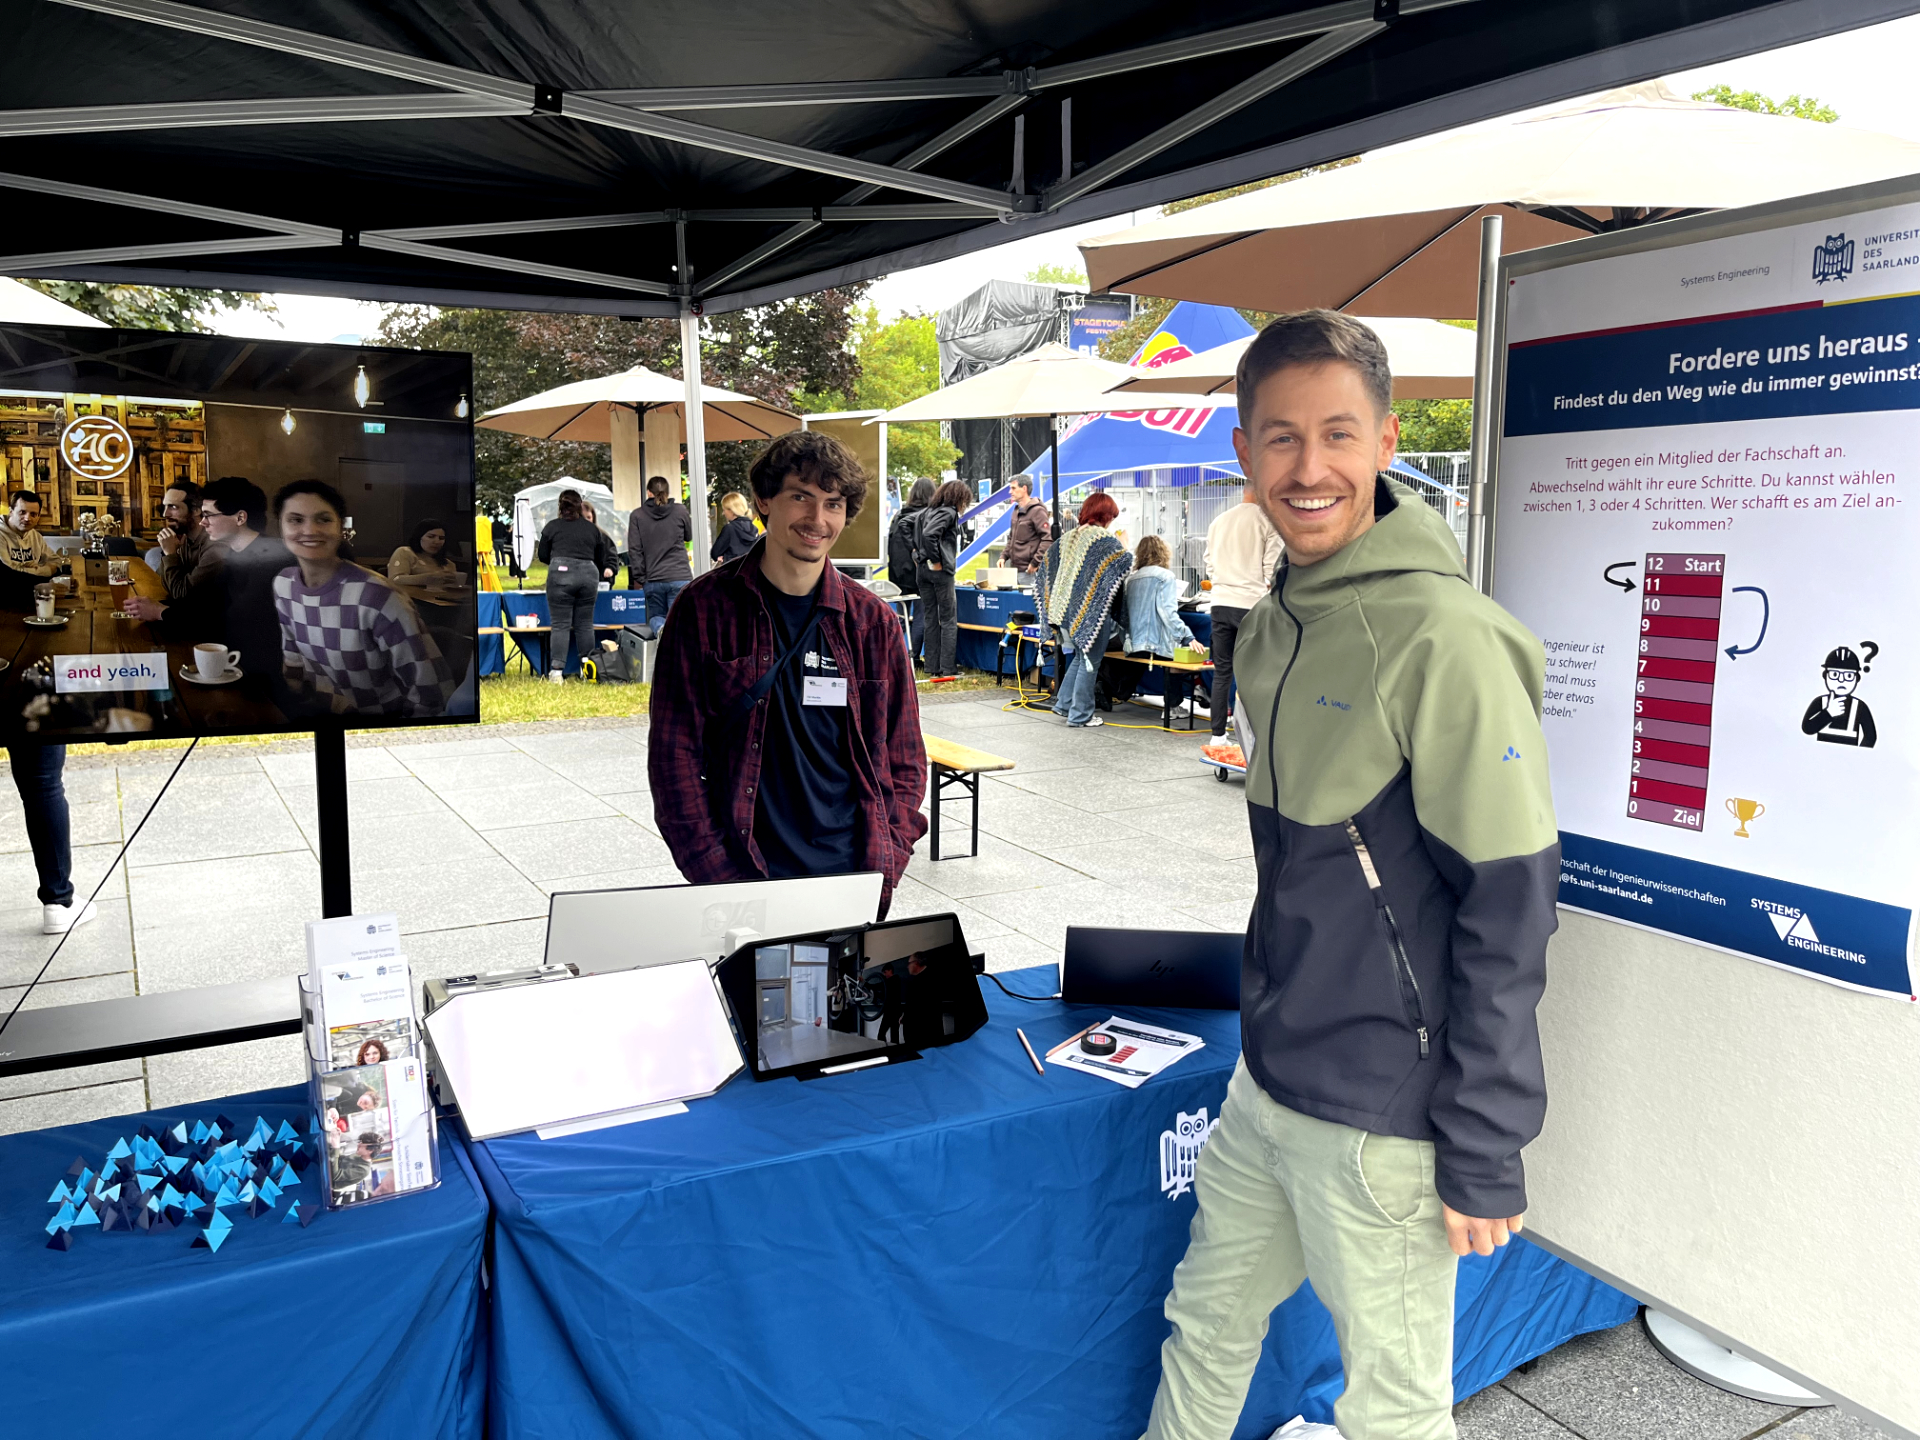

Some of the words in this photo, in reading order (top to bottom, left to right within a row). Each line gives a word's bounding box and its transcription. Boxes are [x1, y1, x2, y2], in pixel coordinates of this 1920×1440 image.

[1864, 228, 1920, 246] UNIVERSIT
[1863, 248, 1882, 259] DES
[1862, 255, 1920, 272] SAARLAND
[1681, 275, 1715, 288] Systems
[1717, 265, 1770, 281] Engineering
[1073, 318, 1127, 328] STAGETOPIA
[1668, 347, 1760, 374] Fordere
[1767, 342, 1811, 365] uns
[1818, 333, 1908, 359] heraus
[1553, 393, 1605, 411] Findest
[1607, 390, 1628, 406] du
[1632, 387, 1662, 404] den
[1666, 384, 1703, 403] Weg
[1708, 380, 1737, 397] wie
[1741, 377, 1763, 394] du
[1768, 375, 1826, 392] immer
[70, 432, 126, 464] AC
[1565, 457, 1588, 470] Tritt
[1591, 456, 1631, 472] gegen
[1634, 453, 1654, 467] ein
[1658, 450, 1714, 468] Mitglied
[1717, 449, 1741, 463] der
[1744, 444, 1820, 462] Fachschaft
[1824, 446, 1847, 459] an.
[1529, 479, 1605, 494] Abwechselnd
[1608, 477, 1643, 492] wählt
[1646, 477, 1664, 491] ihr
[1667, 477, 1697, 490] eure
[1701, 474, 1756, 489] Schritte.
[1761, 473, 1781, 487] Du
[1786, 472, 1835, 487] kannst
[1839, 469, 1896, 485] wählen
[1523, 500, 1572, 513] zwischen
[1576, 499, 1586, 513] 1,
[1589, 498, 1596, 512] 3
[1600, 498, 1629, 511] oder
[1632, 498, 1641, 511] 4
[1644, 497, 1706, 511] Schritten.
[1711, 496, 1738, 510] Wer
[1741, 494, 1790, 509] schafft
[1793, 496, 1809, 509] es
[1813, 496, 1837, 508] am
[1842, 493, 1871, 508] Ziel
[1875, 495, 1902, 508] an-
[1652, 517, 1733, 531] zukommen?
[1647, 557, 1664, 571] 12
[1684, 558, 1722, 572] Start
[1645, 578, 1661, 591] 11
[1644, 598, 1661, 612] 10
[1641, 618, 1650, 632] 9
[1543, 639, 1590, 653] Ingenieur
[1592, 642, 1605, 655] ist
[1639, 639, 1649, 652] 8
[1545, 657, 1556, 667] zu
[1558, 657, 1597, 671] schwer!
[1638, 660, 1647, 673] 7
[67, 664, 102, 679] and
[107, 663, 157, 682] yeah,
[1570, 676, 1597, 688] muss
[1636, 680, 1645, 693] 6
[1542, 688, 1564, 700] aber
[1565, 692, 1595, 705] etwas
[1635, 700, 1643, 713] 5
[1634, 720, 1643, 733] 4
[1633, 740, 1642, 753] 3
[1632, 760, 1641, 773] 2
[1631, 780, 1638, 793] 1
[1628, 800, 1638, 814] 0
[1672, 809, 1701, 827] Ziel
[1558, 872, 1654, 905] @fs.uni-saarland.de
[1592, 865, 1608, 877] der
[1609, 869, 1727, 907] Ingenieurwissenschaften
[1750, 897, 1801, 919] SYSTEMS
[1787, 935, 1867, 965] ENGINEERING
